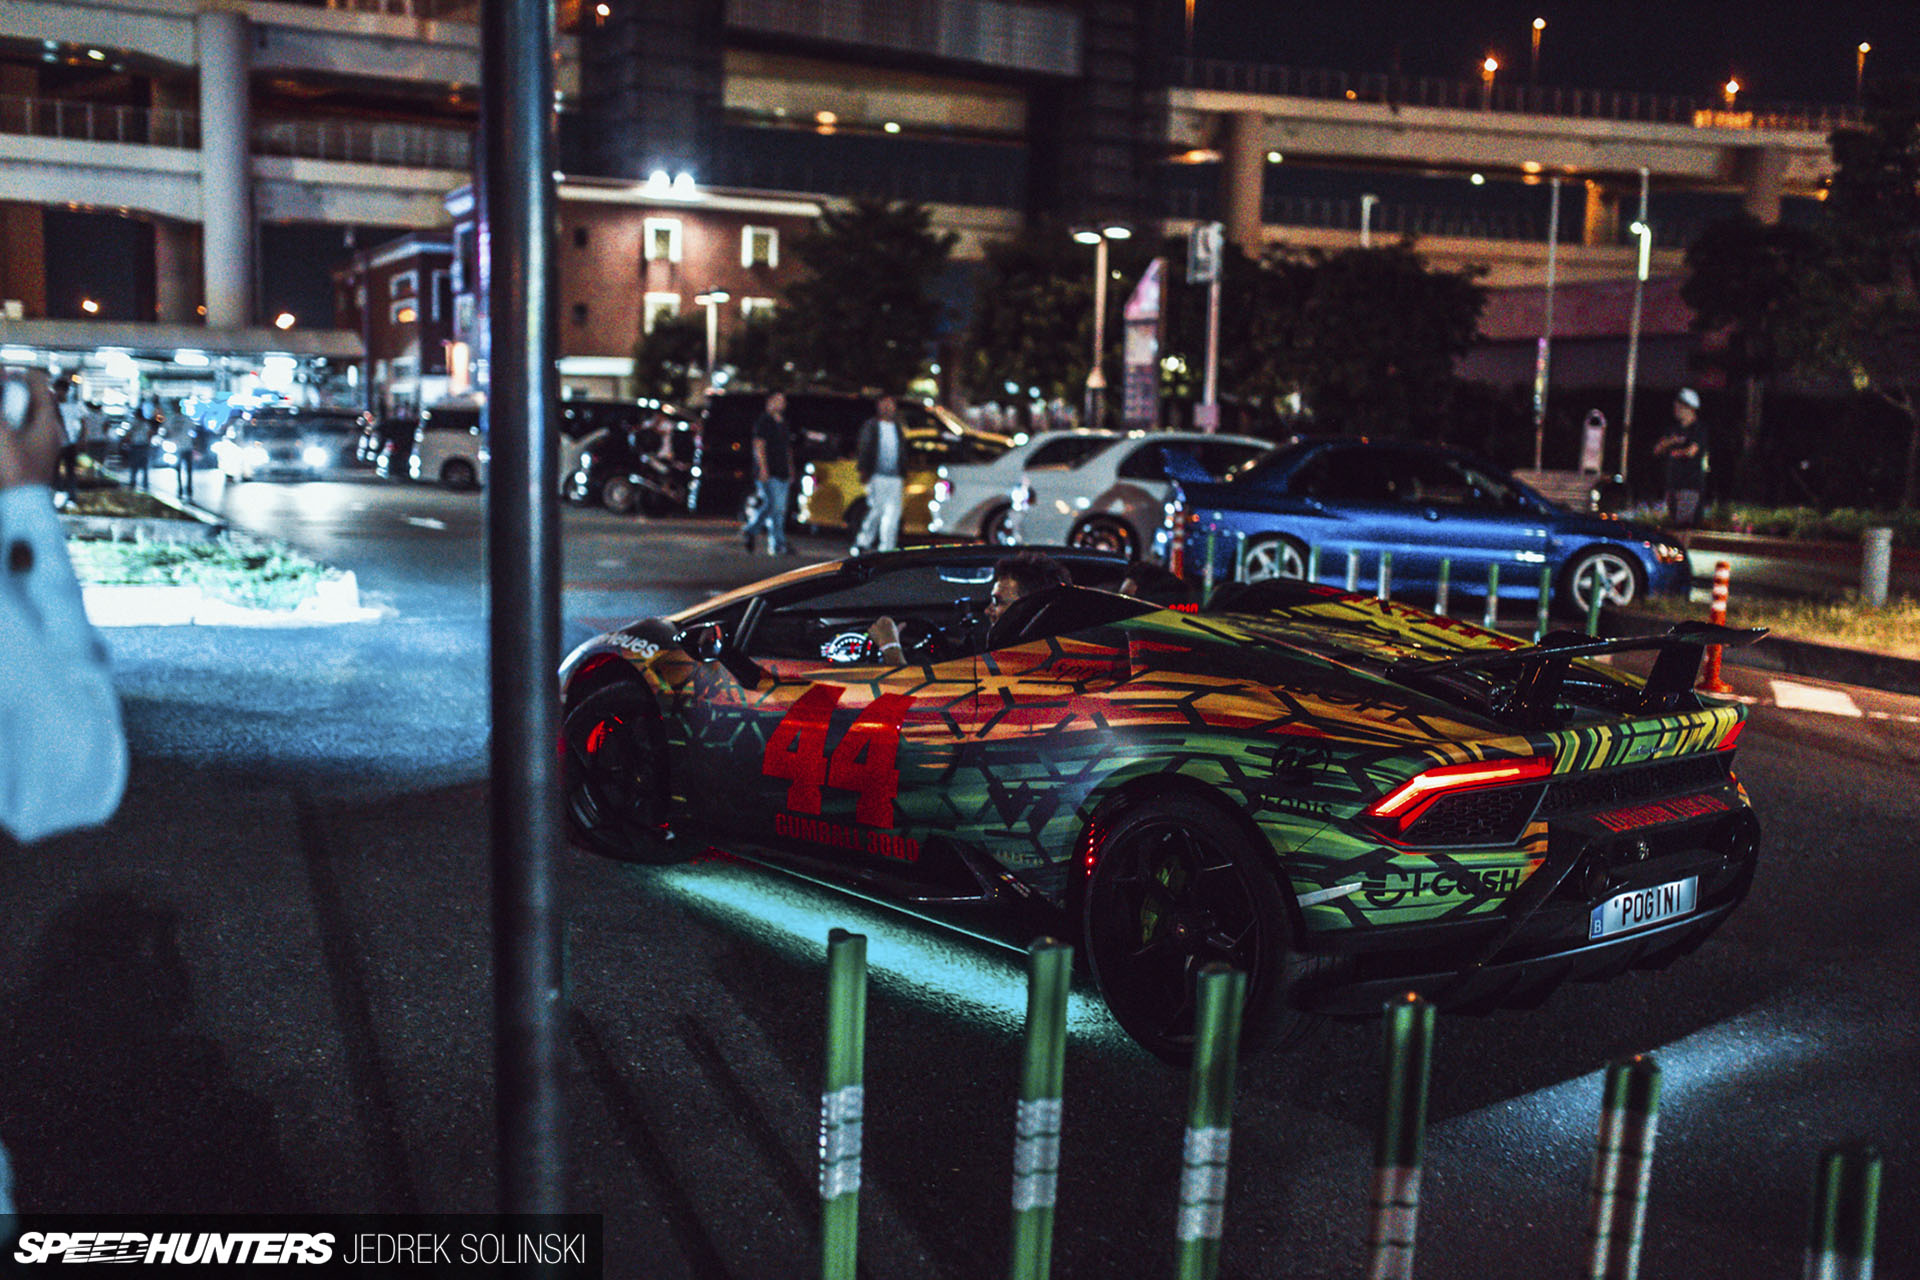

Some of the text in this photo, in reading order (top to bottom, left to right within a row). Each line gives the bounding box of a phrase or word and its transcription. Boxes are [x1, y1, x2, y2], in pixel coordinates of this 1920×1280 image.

[761, 683, 918, 830] 44
[775, 813, 920, 862] GUMBALL 3000
[1593, 919, 1602, 934] B
[1622, 883, 1681, 926] POGINI
